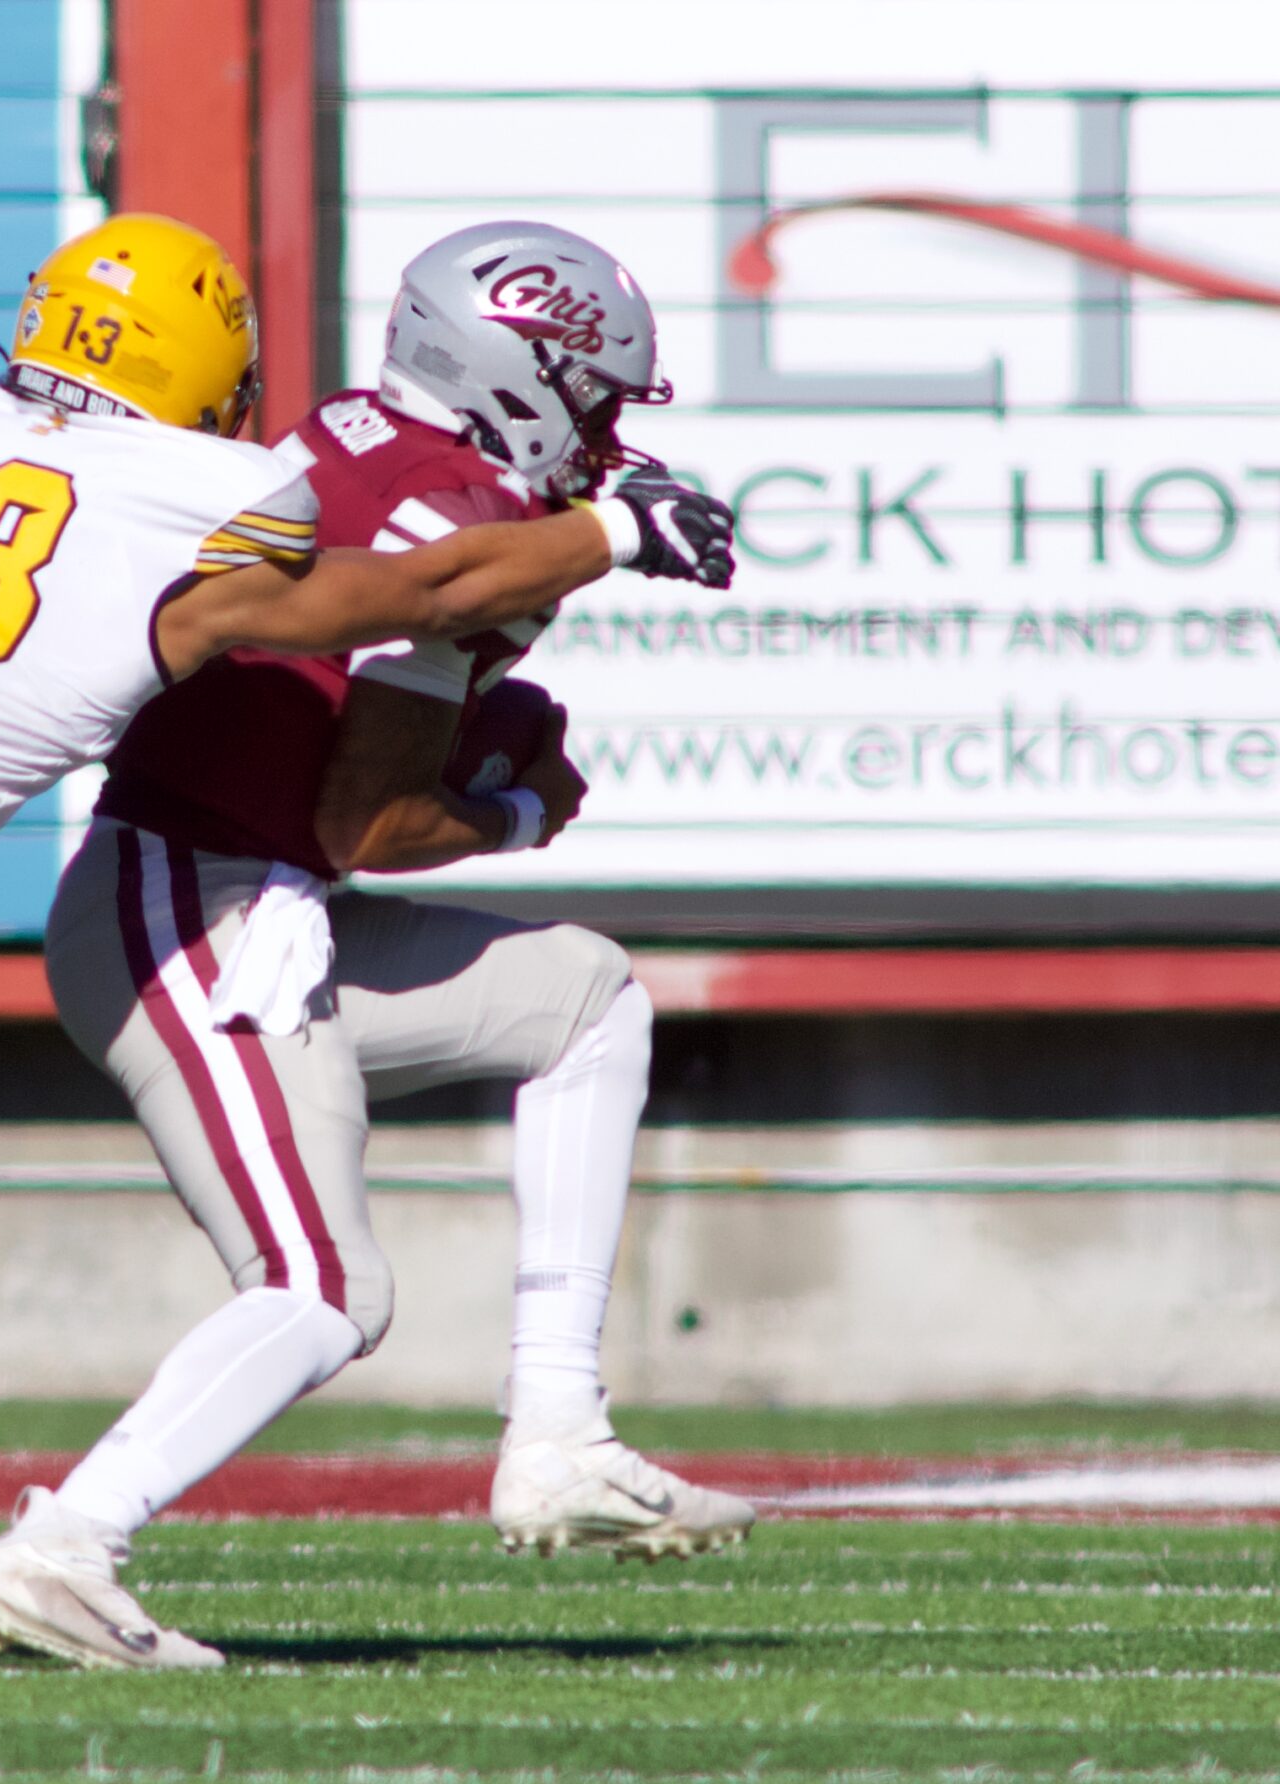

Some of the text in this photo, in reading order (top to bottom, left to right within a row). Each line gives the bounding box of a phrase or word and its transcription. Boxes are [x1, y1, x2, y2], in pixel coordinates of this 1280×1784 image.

[62, 305, 122, 366] 13
[488, 264, 607, 354] Griz
[53, 380, 86, 409] AND
[1006, 606, 1150, 656] AND
